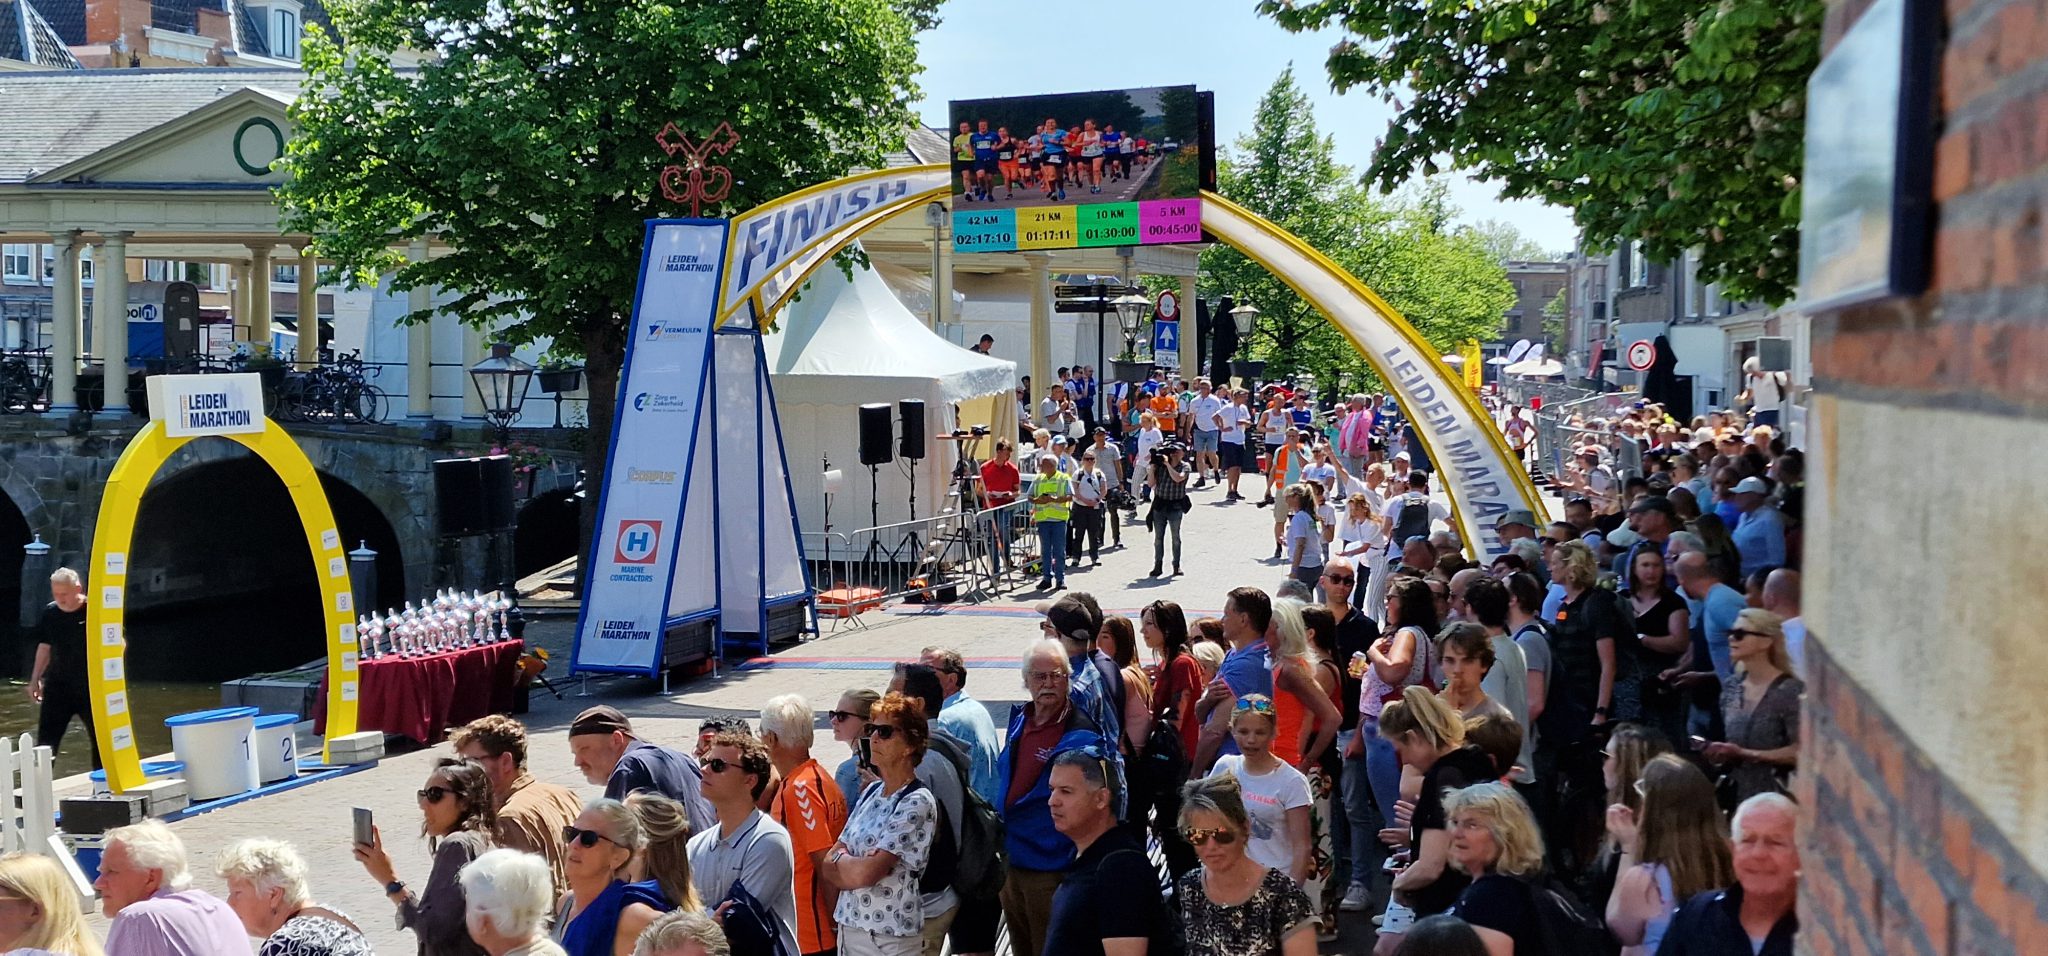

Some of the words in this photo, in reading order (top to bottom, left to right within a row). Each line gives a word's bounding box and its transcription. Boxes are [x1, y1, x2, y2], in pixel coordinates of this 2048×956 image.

[1035, 213, 1046, 222] 21
[1049, 212, 1061, 220] KM
[1096, 210, 1108, 219] 10
[1111, 210, 1124, 218] KM
[1160, 208, 1167, 217] 5
[1170, 207, 1185, 216] KM
[968, 217, 980, 225] 42
[983, 216, 998, 224] KM
[1026, 229, 1071, 241] 01:17:11
[1086, 226, 1135, 239] 01:30:00
[1149, 223, 1198, 236] 00:45:00
[737, 179, 907, 293] FINISH
[956, 233, 1011, 245] 02:17:10
[667, 255, 698, 263] LEIDEN
[665, 263, 714, 272] MARATHON
[1383, 346, 1462, 436] LEIDEN
[189, 393, 227, 410] LEIDEN
[190, 410, 251, 428] MARATHON
[627, 531, 649, 552] H
[610, 574, 653, 582] CONTRACTORS
[603, 621, 635, 630] LEIDEN
[601, 630, 651, 640] MARATHON
[242, 736, 250, 761] 1
[282, 737, 293, 762] 2
